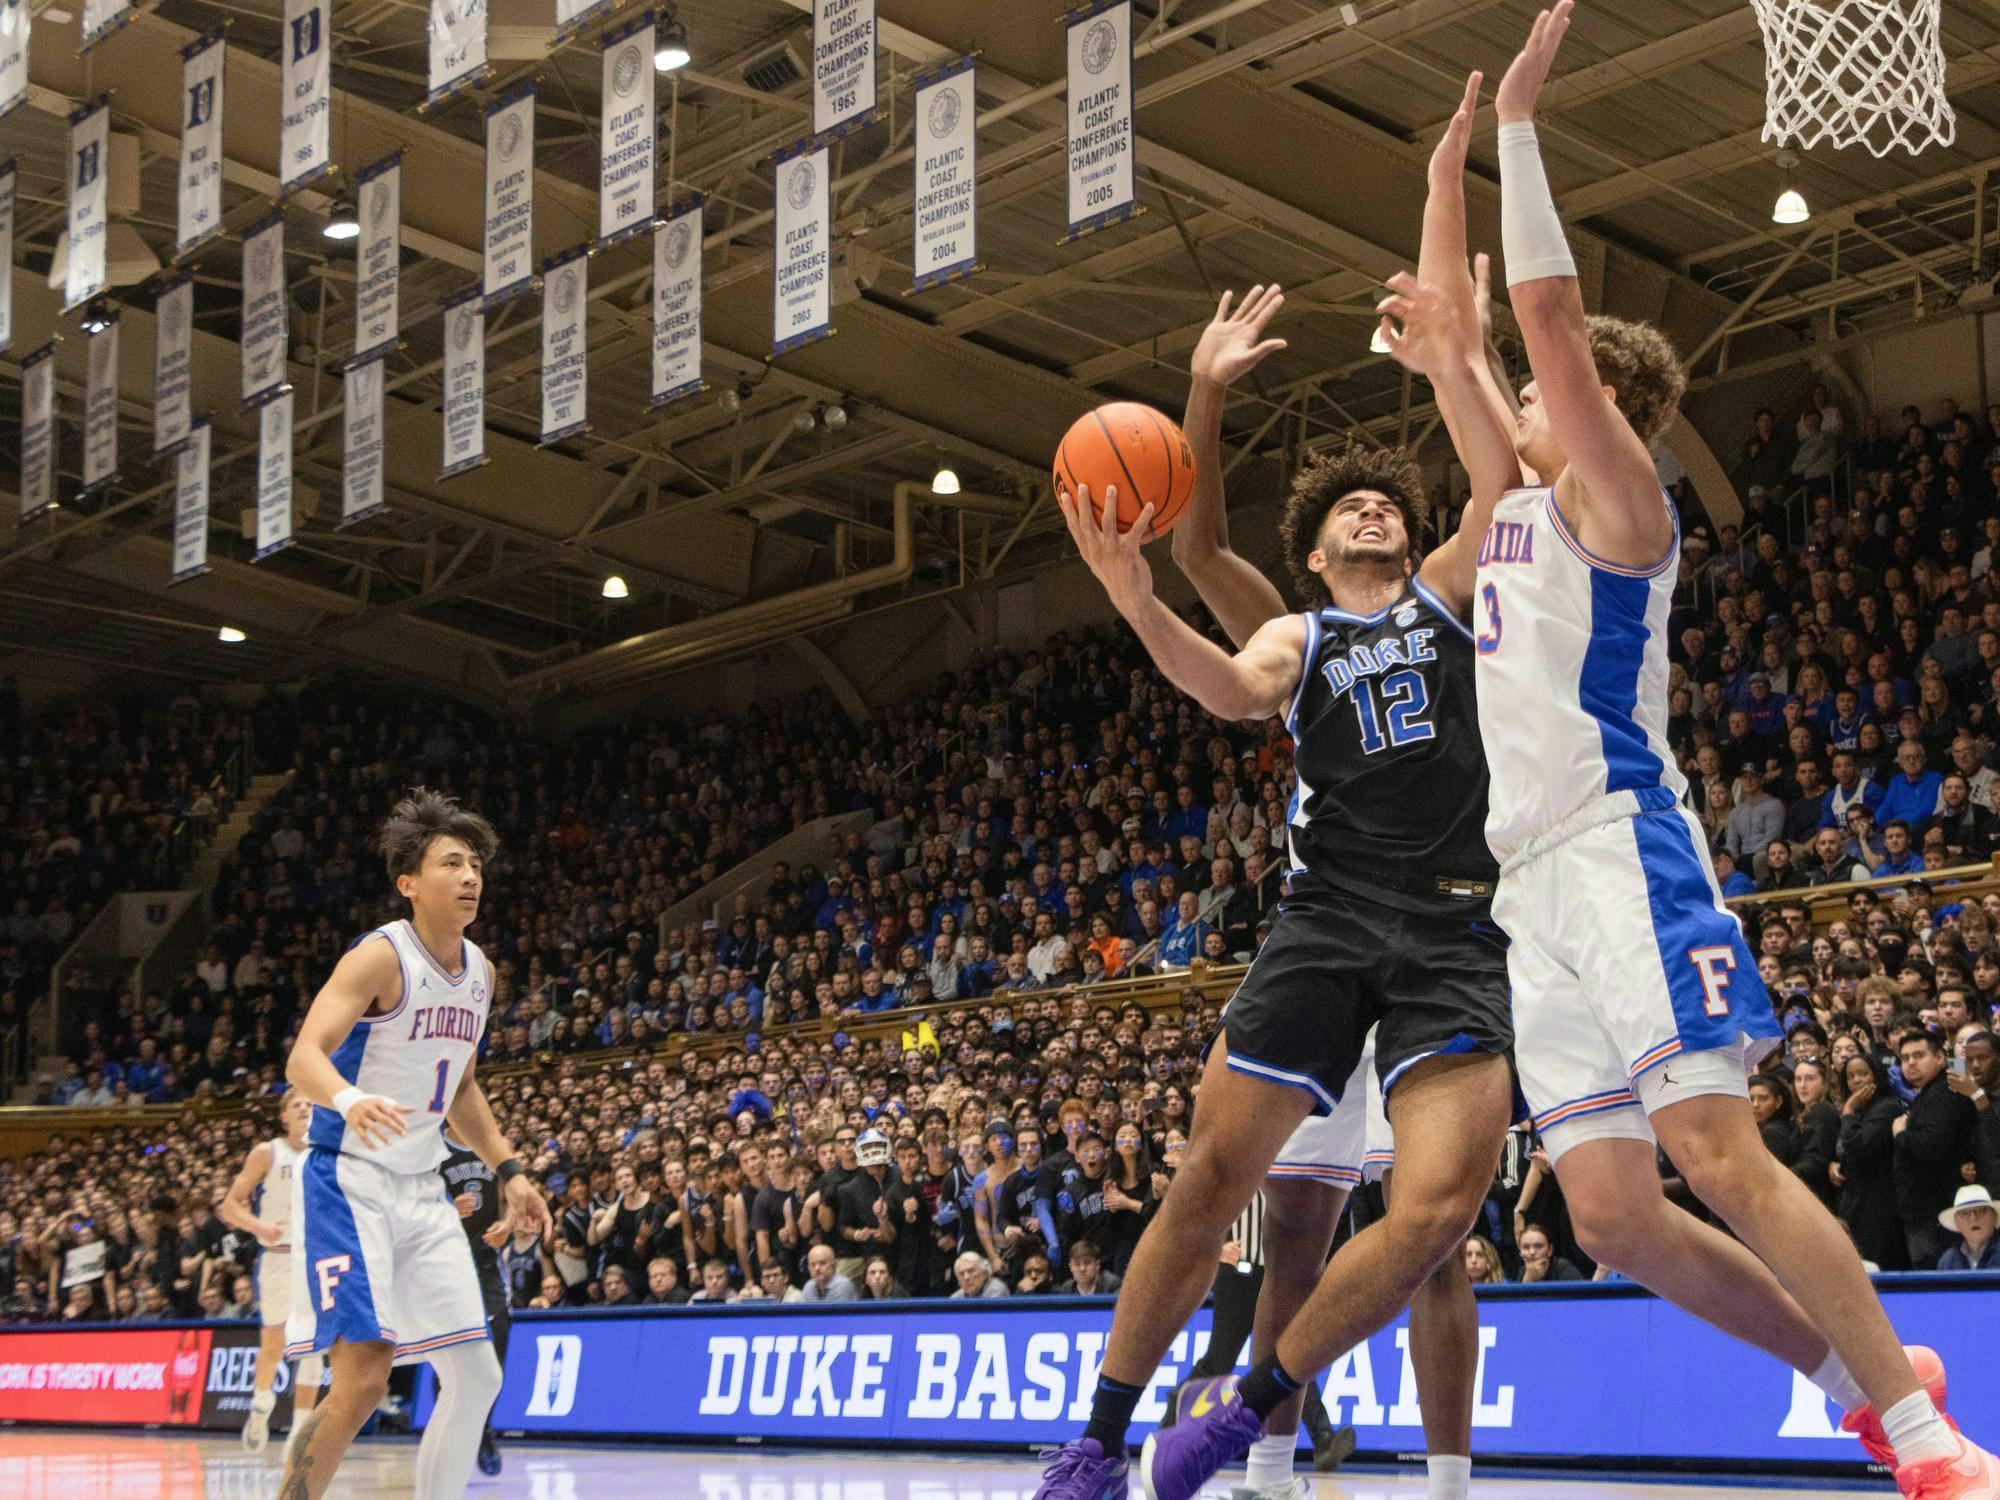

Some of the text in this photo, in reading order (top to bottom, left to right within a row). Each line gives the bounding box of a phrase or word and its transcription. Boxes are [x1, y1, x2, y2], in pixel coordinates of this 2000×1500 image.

[823, 0, 861, 20] ATLAN
[830, 8, 858, 35] COAST
[815, 20, 872, 62] CONFERENCE
[817, 41, 869, 79] CHAMPIONS
[832, 91, 856, 113] 1963
[1077, 84, 1120, 115] ATLANTIC
[610, 104, 644, 131] ATLANTIC
[1085, 105, 1114, 130] COAST
[615, 124, 638, 147] COAST
[1070, 117, 1129, 154] CONFERENCE
[601, 136, 651, 171] CONFERENCE
[924, 147, 964, 174] ATLANTIC
[1072, 137, 1126, 172] CHAMPIONS
[494, 169, 525, 195] ATLANTIC
[603, 155, 649, 187] CHAMPIONS
[930, 167, 958, 189] COAST
[1081, 163, 1117, 185] TOURNAMENT
[498, 188, 519, 209] COAST
[918, 179, 972, 212] CONFERENCE
[1086, 184, 1113, 207] 2005
[487, 201, 531, 232] CONFERENCE
[919, 198, 970, 228] CHAMPIONS
[488, 218, 528, 248] CHAMPIONS
[785, 220, 818, 244] ATLANTIC
[922, 220, 966, 243] REGULAR SEASON
[789, 239, 813, 260] COAST
[932, 241, 957, 261] 2004
[778, 251, 826, 281] CONFERENCE
[661, 278, 693, 300] ATLANTIC
[780, 268, 824, 297] CHAMPIONS
[655, 307, 699, 336] CONFERENCE
[792, 308, 811, 326] 2003
[550, 322, 577, 343] ATLANTIC
[656, 324, 697, 351] CHAMPIONS
[1477, 581, 1502, 656] 3
[1321, 628, 1437, 699] DUKE
[1349, 668, 1437, 756] 12
[1689, 945, 1737, 1018] F
[427, 1059, 450, 1113] 1
[316, 1254, 351, 1311] F
[33, 1362, 48, 1390] IS
[47, 1362, 114, 1390] THIRSTY
[112, 1362, 167, 1390] WORK
[206, 1347, 290, 1393] REES
[699, 1327, 1515, 1428] DUKE BASKEALL
